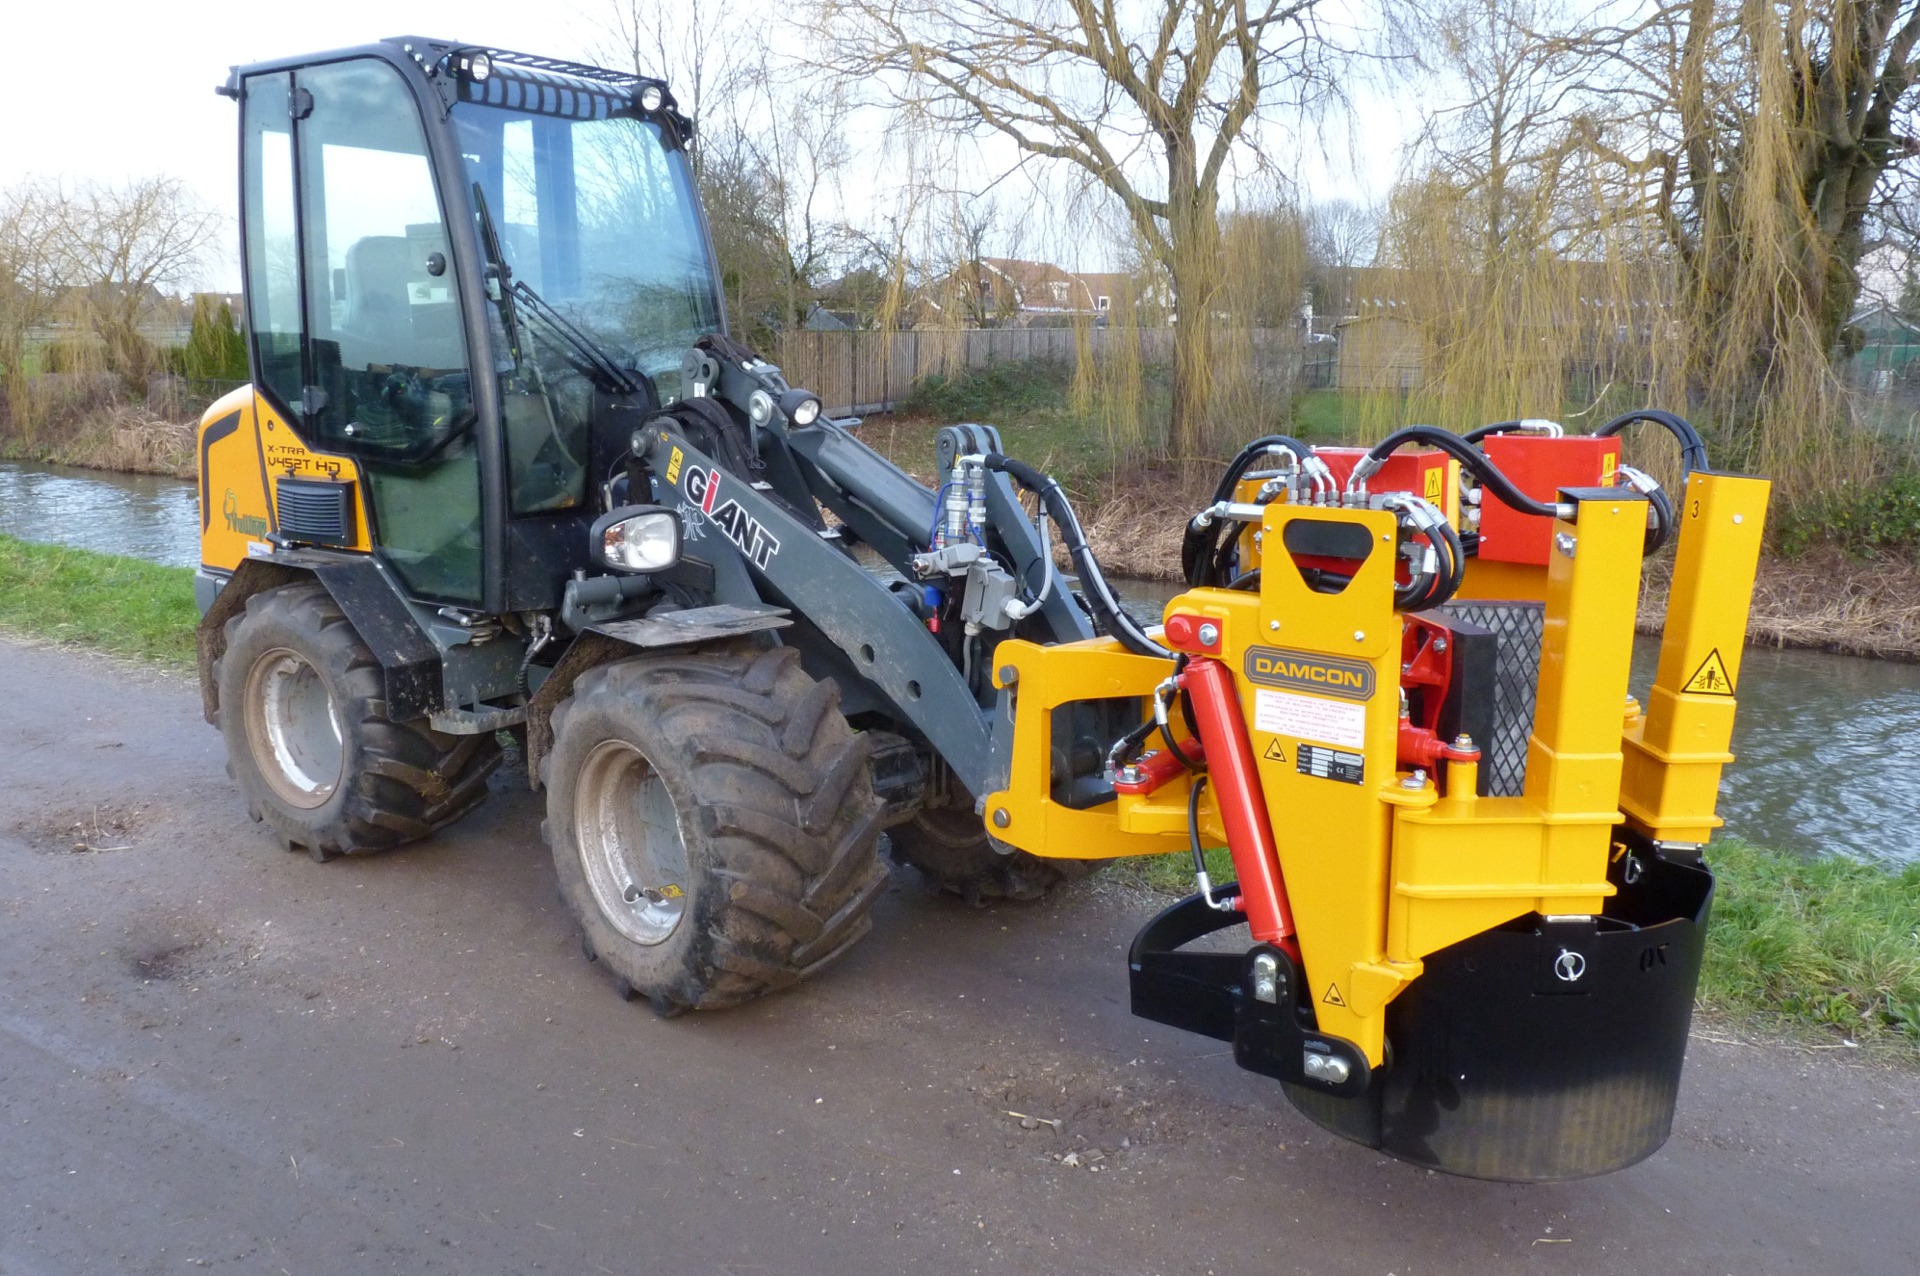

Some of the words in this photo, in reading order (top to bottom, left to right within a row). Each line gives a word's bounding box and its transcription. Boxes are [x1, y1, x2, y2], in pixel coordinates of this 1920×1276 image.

[267, 444, 305, 456] X-TRA
[315, 460, 341, 473] HD
[1692, 500, 1700, 518] 3
[1255, 657, 1363, 688] DAMCON
